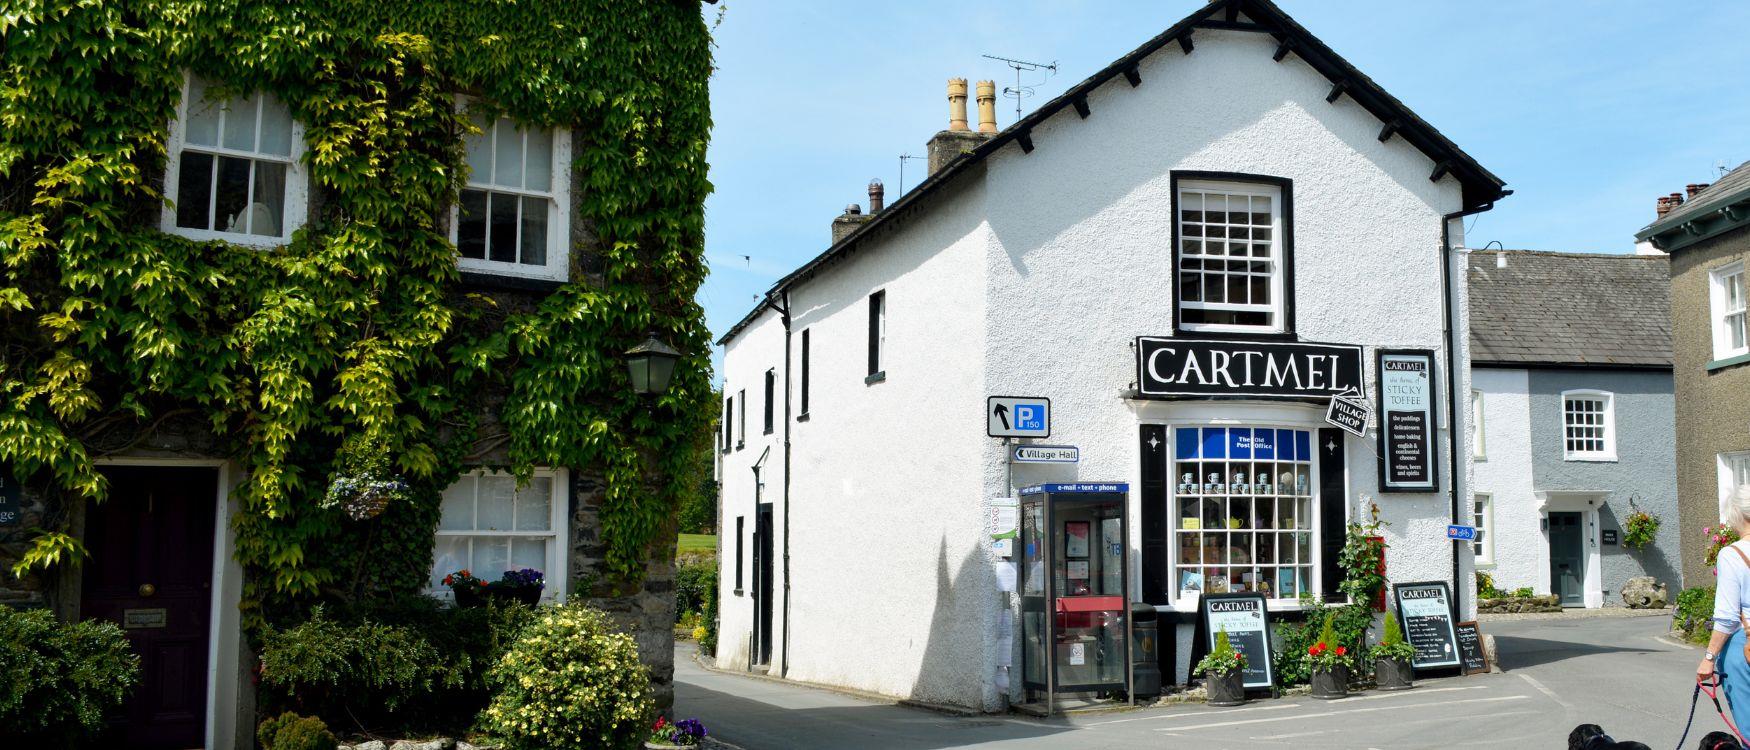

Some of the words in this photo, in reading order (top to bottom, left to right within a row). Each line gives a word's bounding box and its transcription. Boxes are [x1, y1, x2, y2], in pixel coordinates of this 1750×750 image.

[1147, 347, 1349, 391] CARTMEL
[1385, 361, 1424, 371] CARTMEL
[1386, 385, 1422, 395] STICKY
[1390, 395, 1421, 405] TOFFEE
[1335, 401, 1367, 421] VILLAGE
[1018, 407, 1034, 428] P
[1026, 421, 1040, 429] 150
[1337, 413, 1360, 428] SHOP
[1026, 450, 1056, 460] Village
[1059, 451, 1077, 459] Hall
[1402, 589, 1442, 599] CARTMEL
[1211, 601, 1258, 612] CARTMEL
